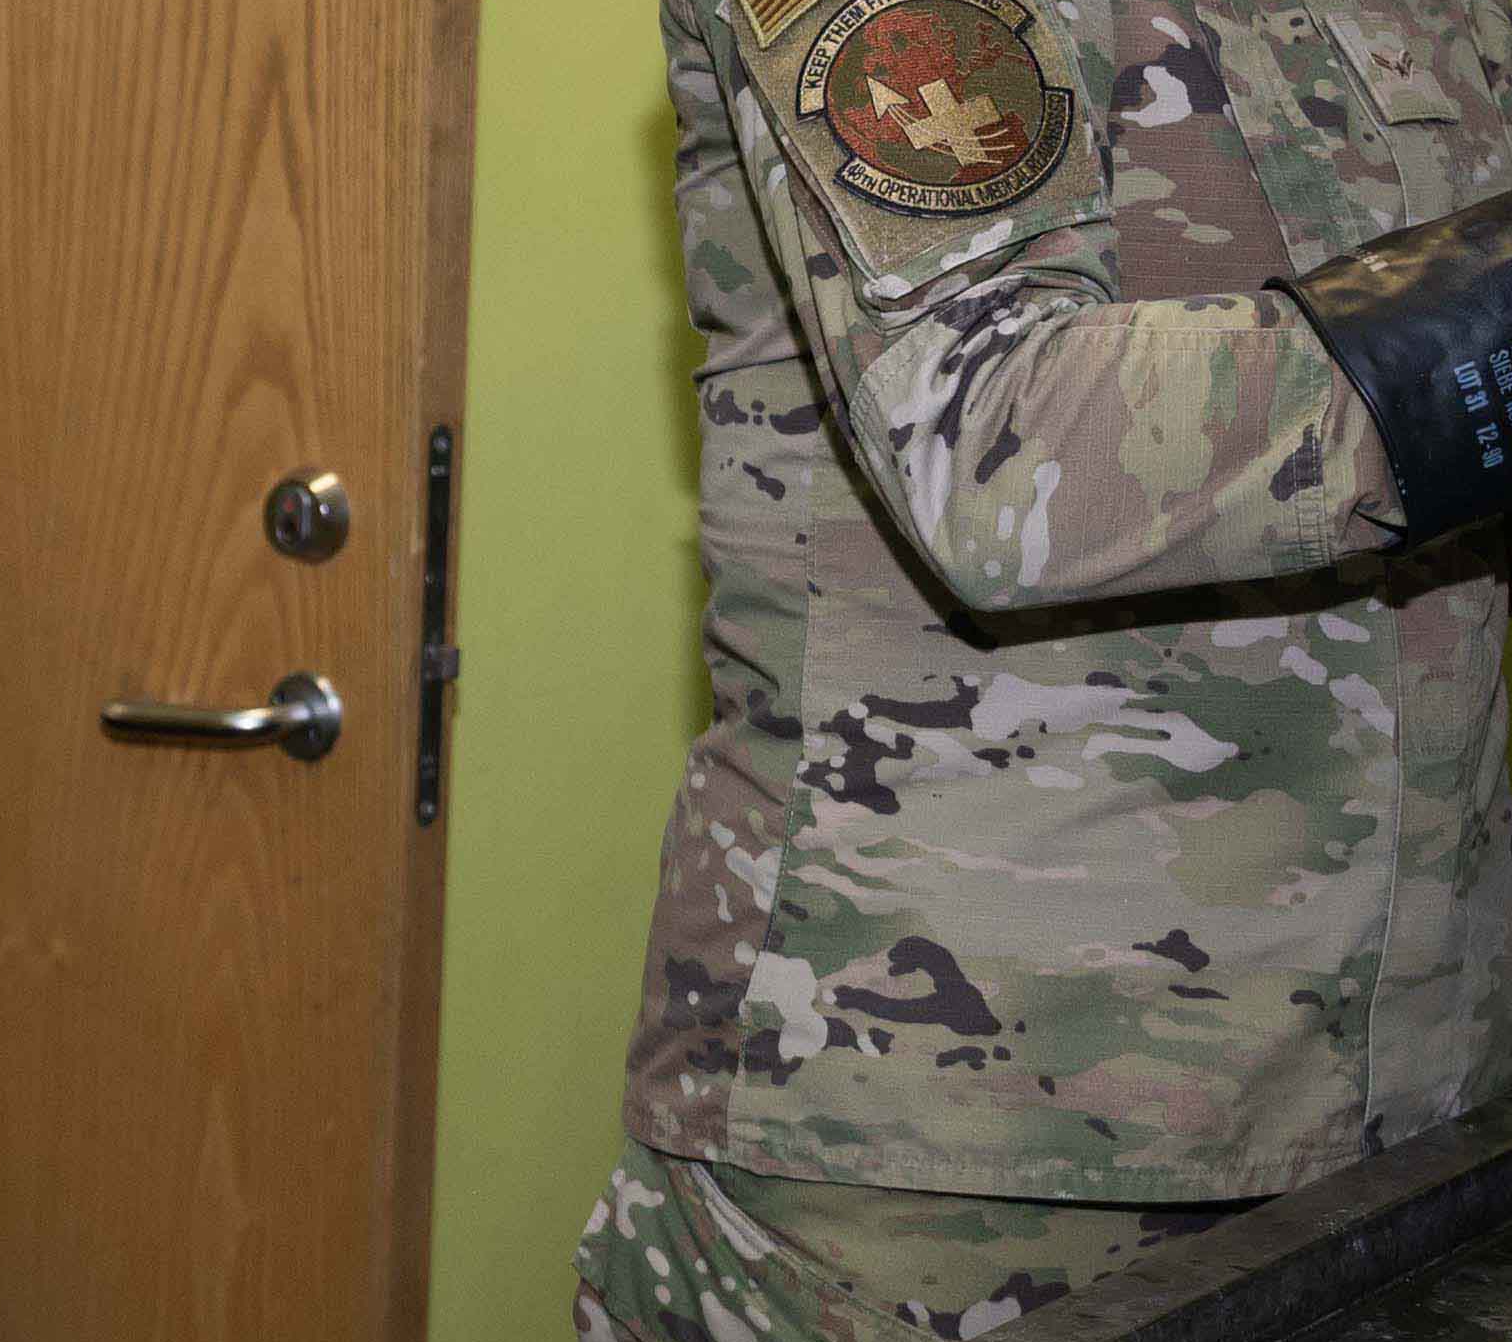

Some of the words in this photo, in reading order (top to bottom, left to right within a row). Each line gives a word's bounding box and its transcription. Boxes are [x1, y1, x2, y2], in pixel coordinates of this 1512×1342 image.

[805, 48, 832, 90] KEEP
[825, 5, 866, 46] THEM
[877, 177, 978, 207] OPERATIONAL
[1453, 360, 1483, 391] LOT
[1475, 421, 1504, 469] 12-90
